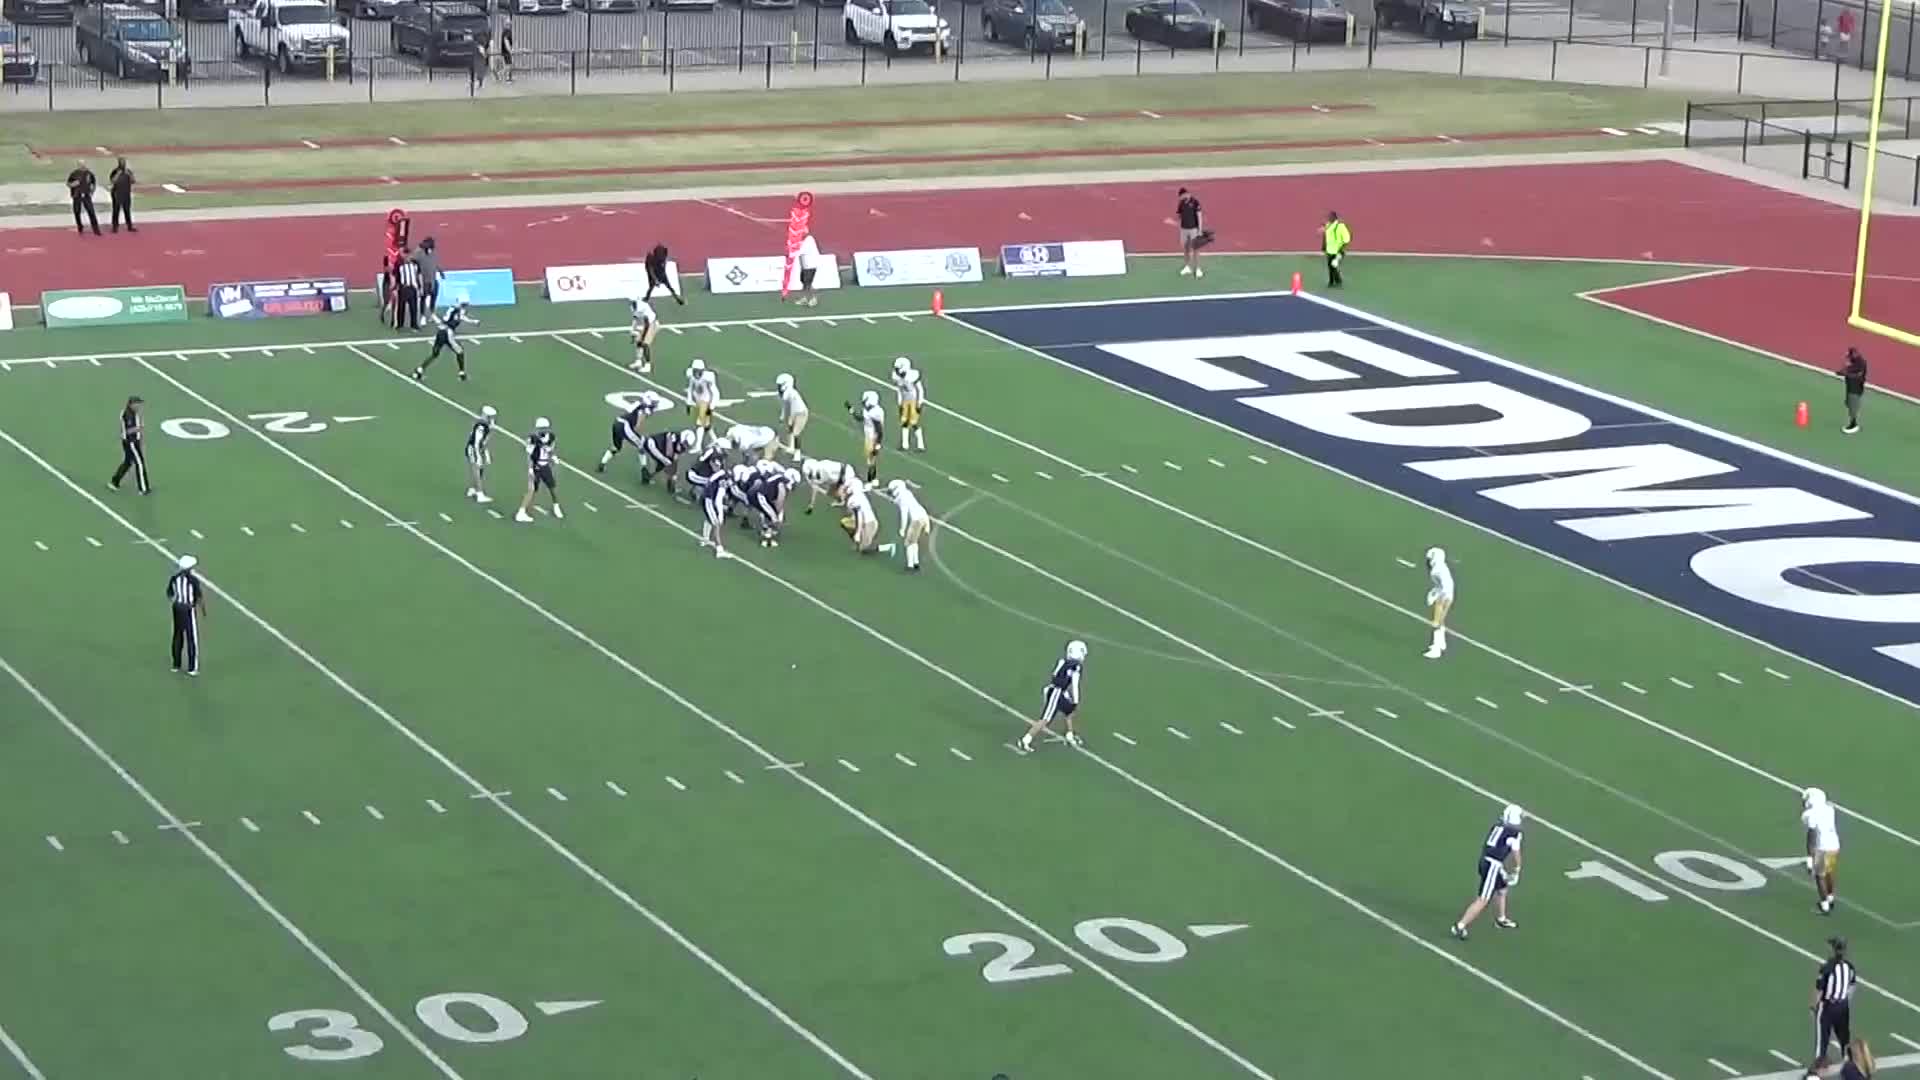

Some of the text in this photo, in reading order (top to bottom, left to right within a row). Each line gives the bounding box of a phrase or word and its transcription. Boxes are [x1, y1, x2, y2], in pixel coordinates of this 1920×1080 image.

[1095, 330, 1919, 670] EDMO
[1564, 850, 1766, 901] 10
[943, 917, 1188, 984] 20
[267, 992, 528, 1061] 30
